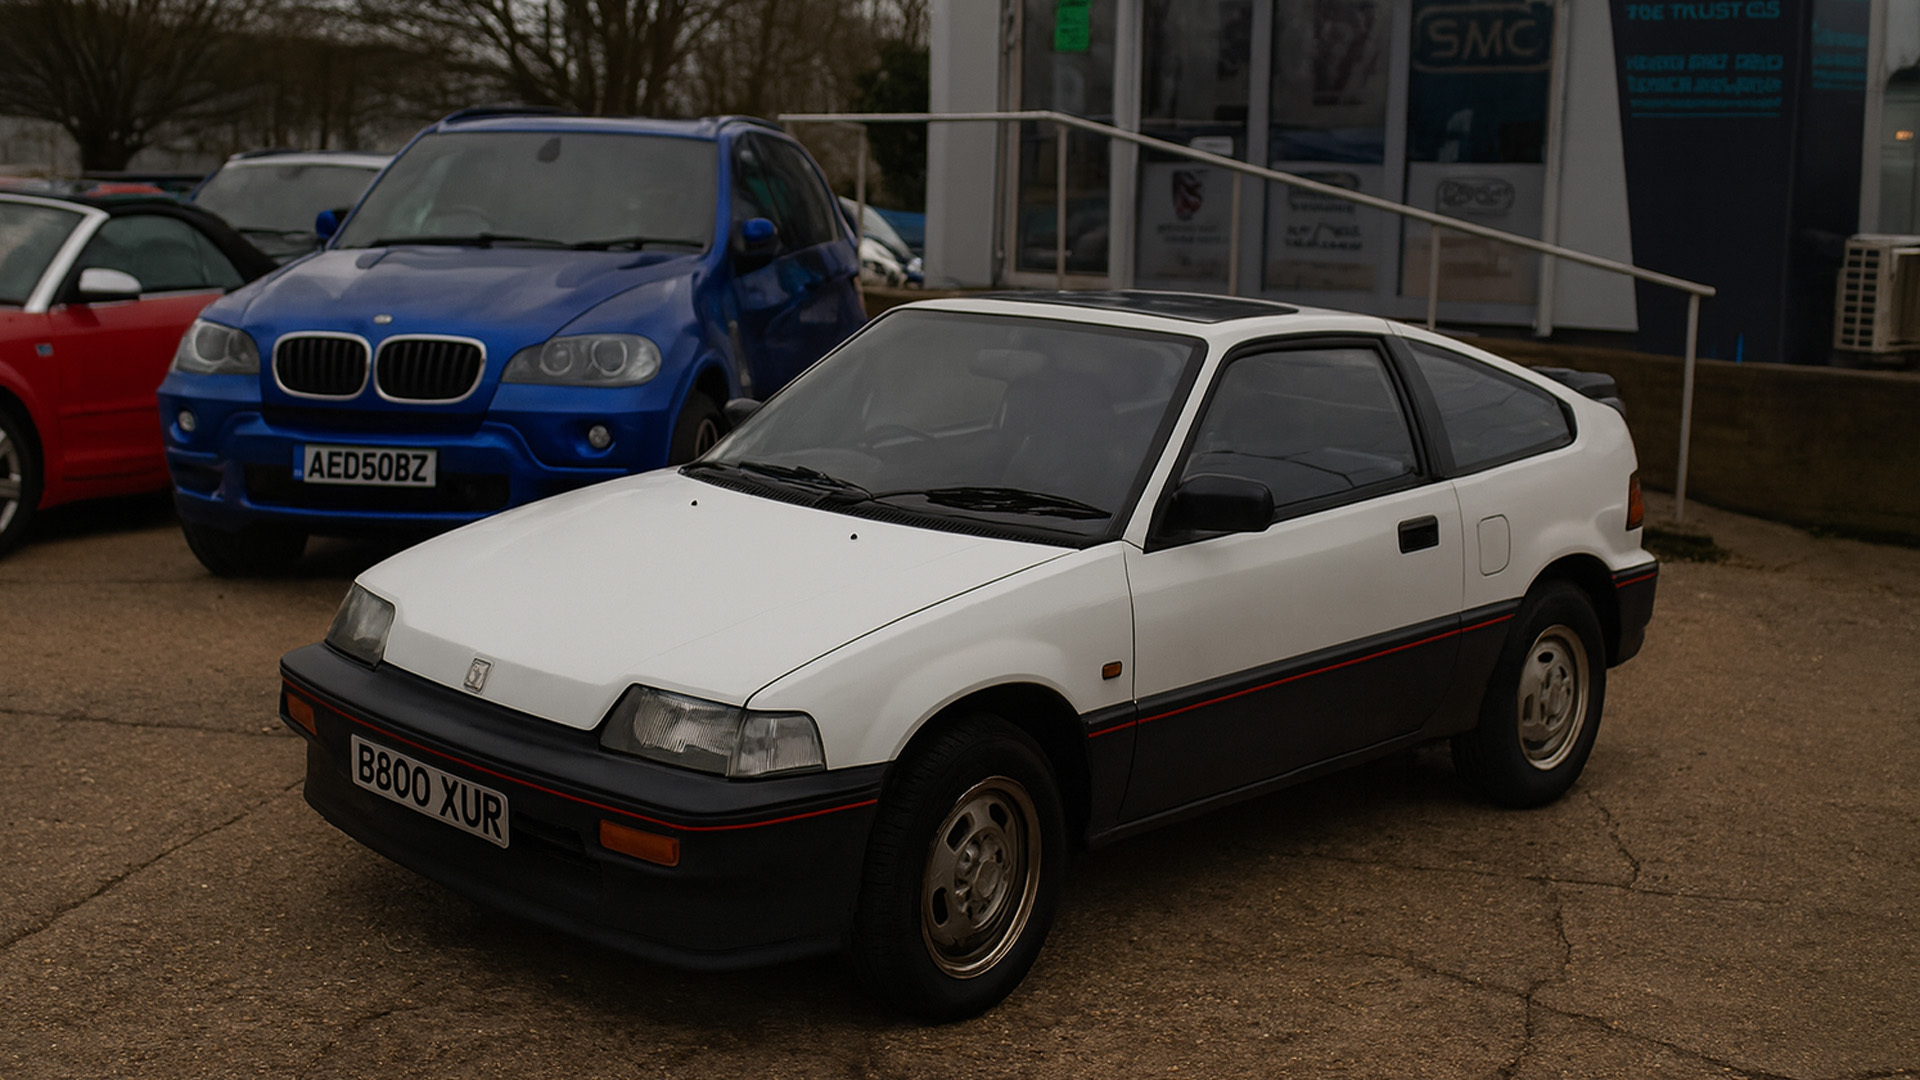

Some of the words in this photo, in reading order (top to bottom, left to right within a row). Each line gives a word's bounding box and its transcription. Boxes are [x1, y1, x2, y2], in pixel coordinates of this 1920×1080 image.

[1428, 18, 1538, 60] SMC
[358, 743, 431, 807] B800
[439, 775, 502, 840] XUR
